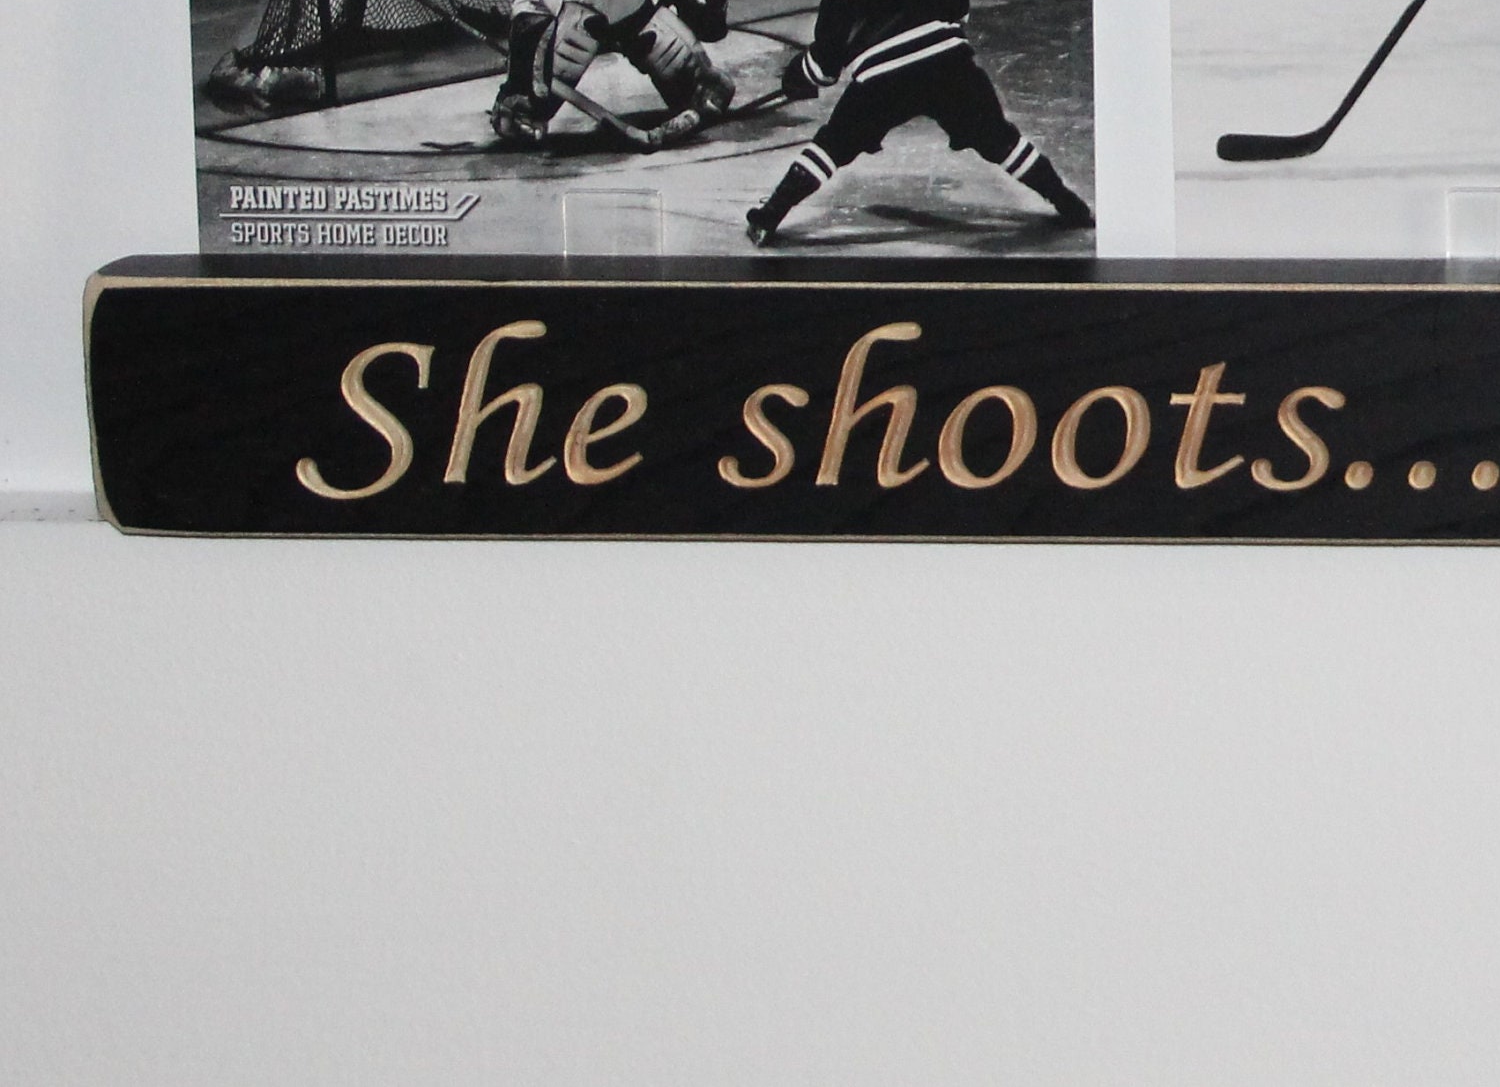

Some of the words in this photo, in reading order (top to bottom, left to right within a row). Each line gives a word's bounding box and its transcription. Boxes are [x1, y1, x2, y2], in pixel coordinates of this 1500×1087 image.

[230, 185, 328, 211] PAINTED
[335, 185, 448, 212] PASTIMES
[231, 222, 310, 246] SPORTS
[317, 223, 375, 246] HOME
[382, 223, 448, 247] DECOR
[295, 320, 647, 500] She
[717, 322, 1500, 491] shoots...
